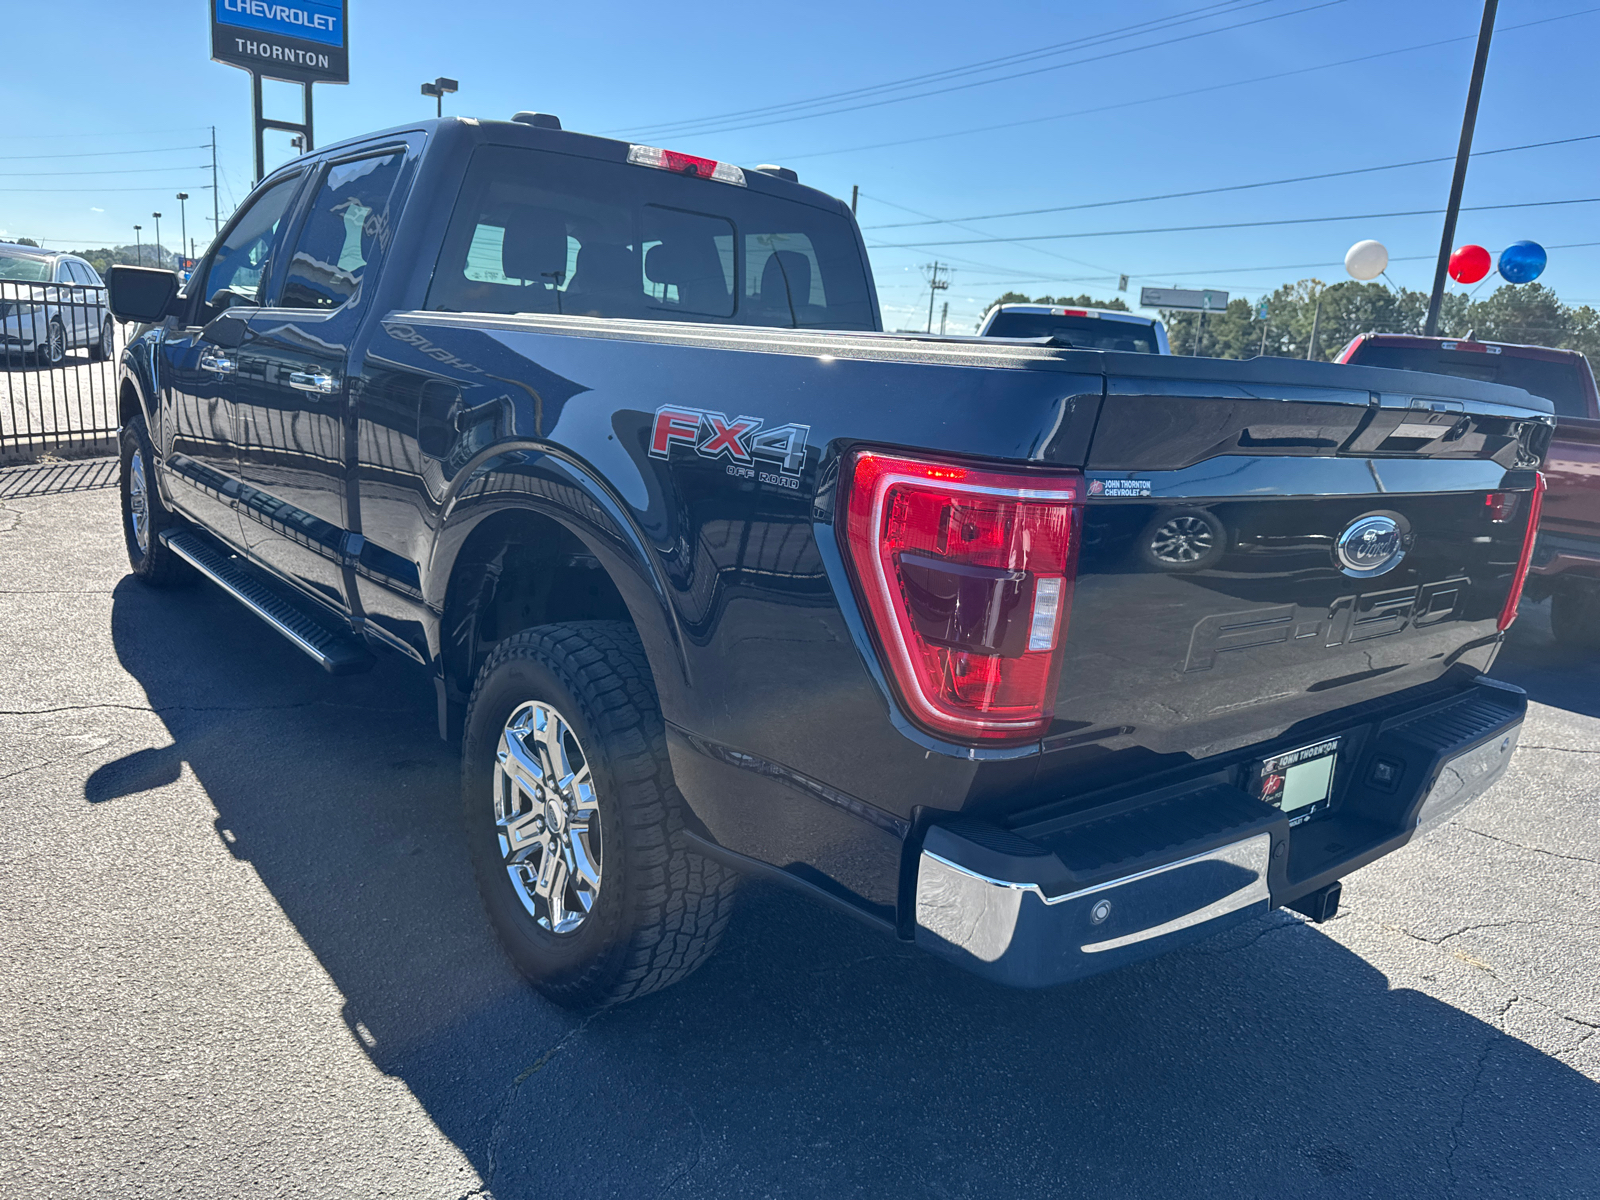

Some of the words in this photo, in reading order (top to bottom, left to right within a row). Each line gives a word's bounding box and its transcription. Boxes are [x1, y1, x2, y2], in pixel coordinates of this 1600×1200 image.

[224, 0, 337, 31] CHEVROLET
[235, 38, 329, 69] THORNTON
[648, 403, 811, 477] FX4
[726, 465, 754, 478] OFF
[759, 472, 800, 489] ROAD
[1105, 480, 1120, 488] JOHN
[1121, 480, 1151, 489] THORNTON
[1356, 529, 1395, 559] Ford
[1183, 577, 1472, 673] F-150
[1279, 753, 1300, 766] JOHN
[1300, 741, 1338, 761] THORNTON
